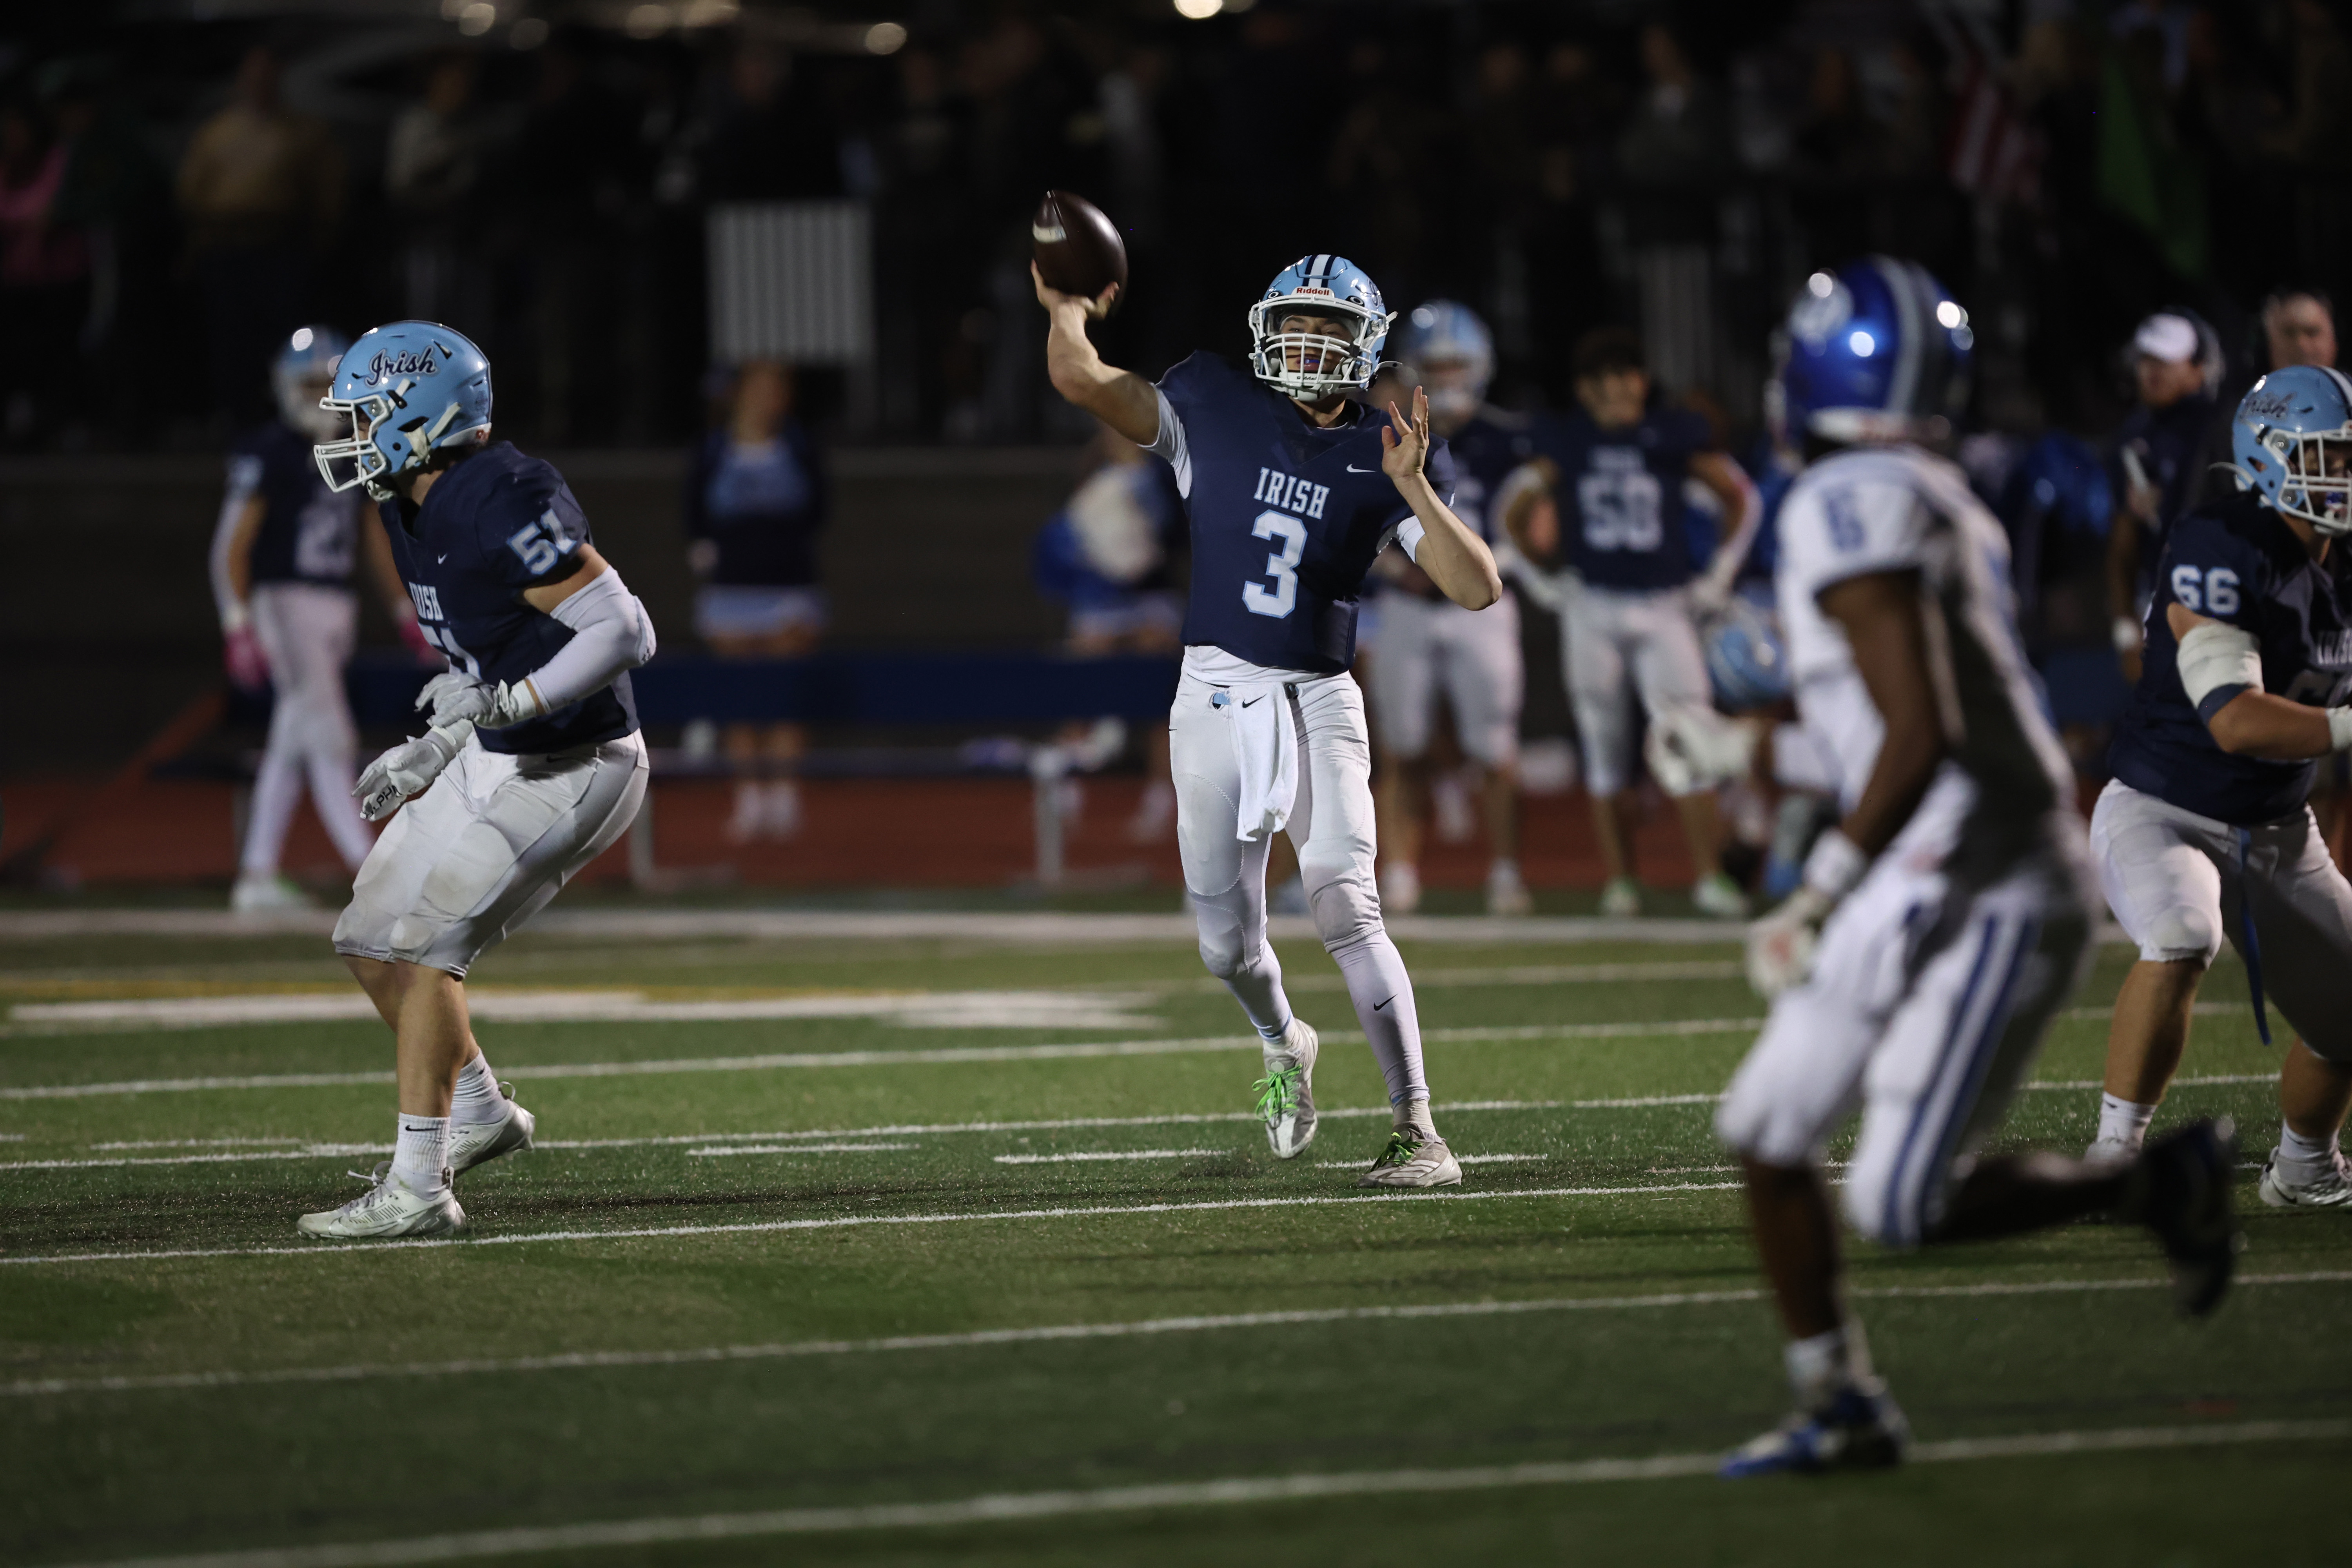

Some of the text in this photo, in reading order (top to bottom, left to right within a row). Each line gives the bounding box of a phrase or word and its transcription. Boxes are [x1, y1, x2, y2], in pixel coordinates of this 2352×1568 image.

[1296, 287, 1330, 296] Riddell
[366, 346, 436, 387] Irish
[1253, 466, 1330, 520] IRISH
[506, 508, 577, 575] 51
[1242, 509, 1308, 619] 3
[2171, 564, 2241, 615] 66
